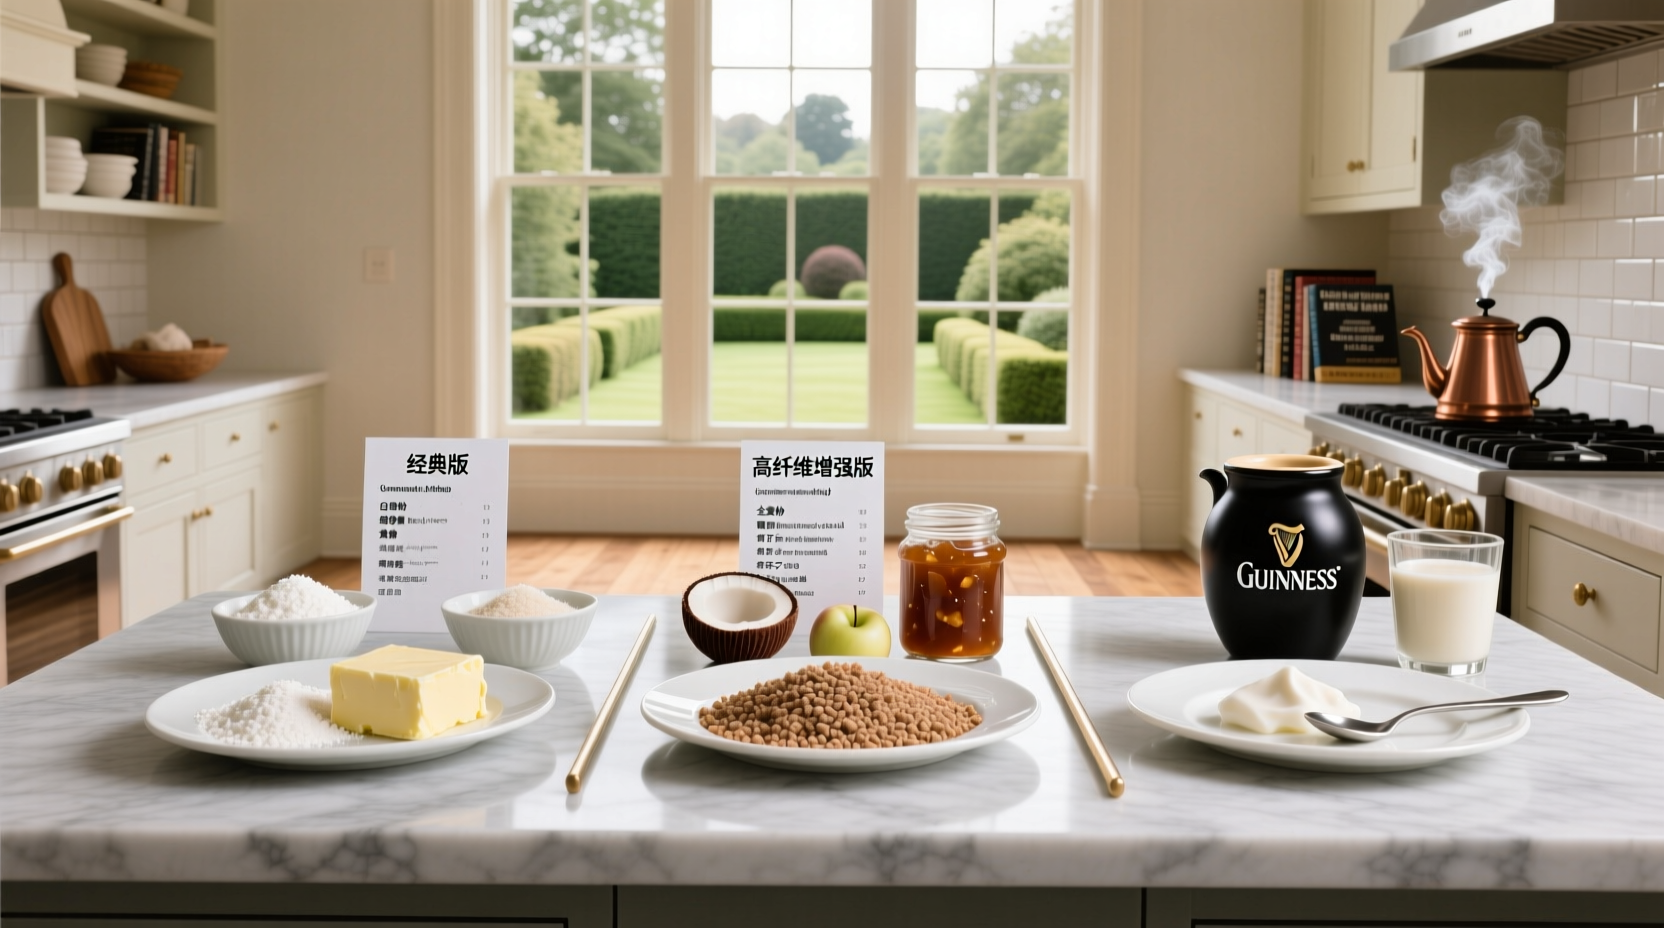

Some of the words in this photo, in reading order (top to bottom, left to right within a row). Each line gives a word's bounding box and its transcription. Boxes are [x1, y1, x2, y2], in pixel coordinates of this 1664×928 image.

[406, 453, 469, 475] 经典版
[752, 455, 874, 478] 高纤维增强版
[1237, 561, 1339, 591] GUINNESS
